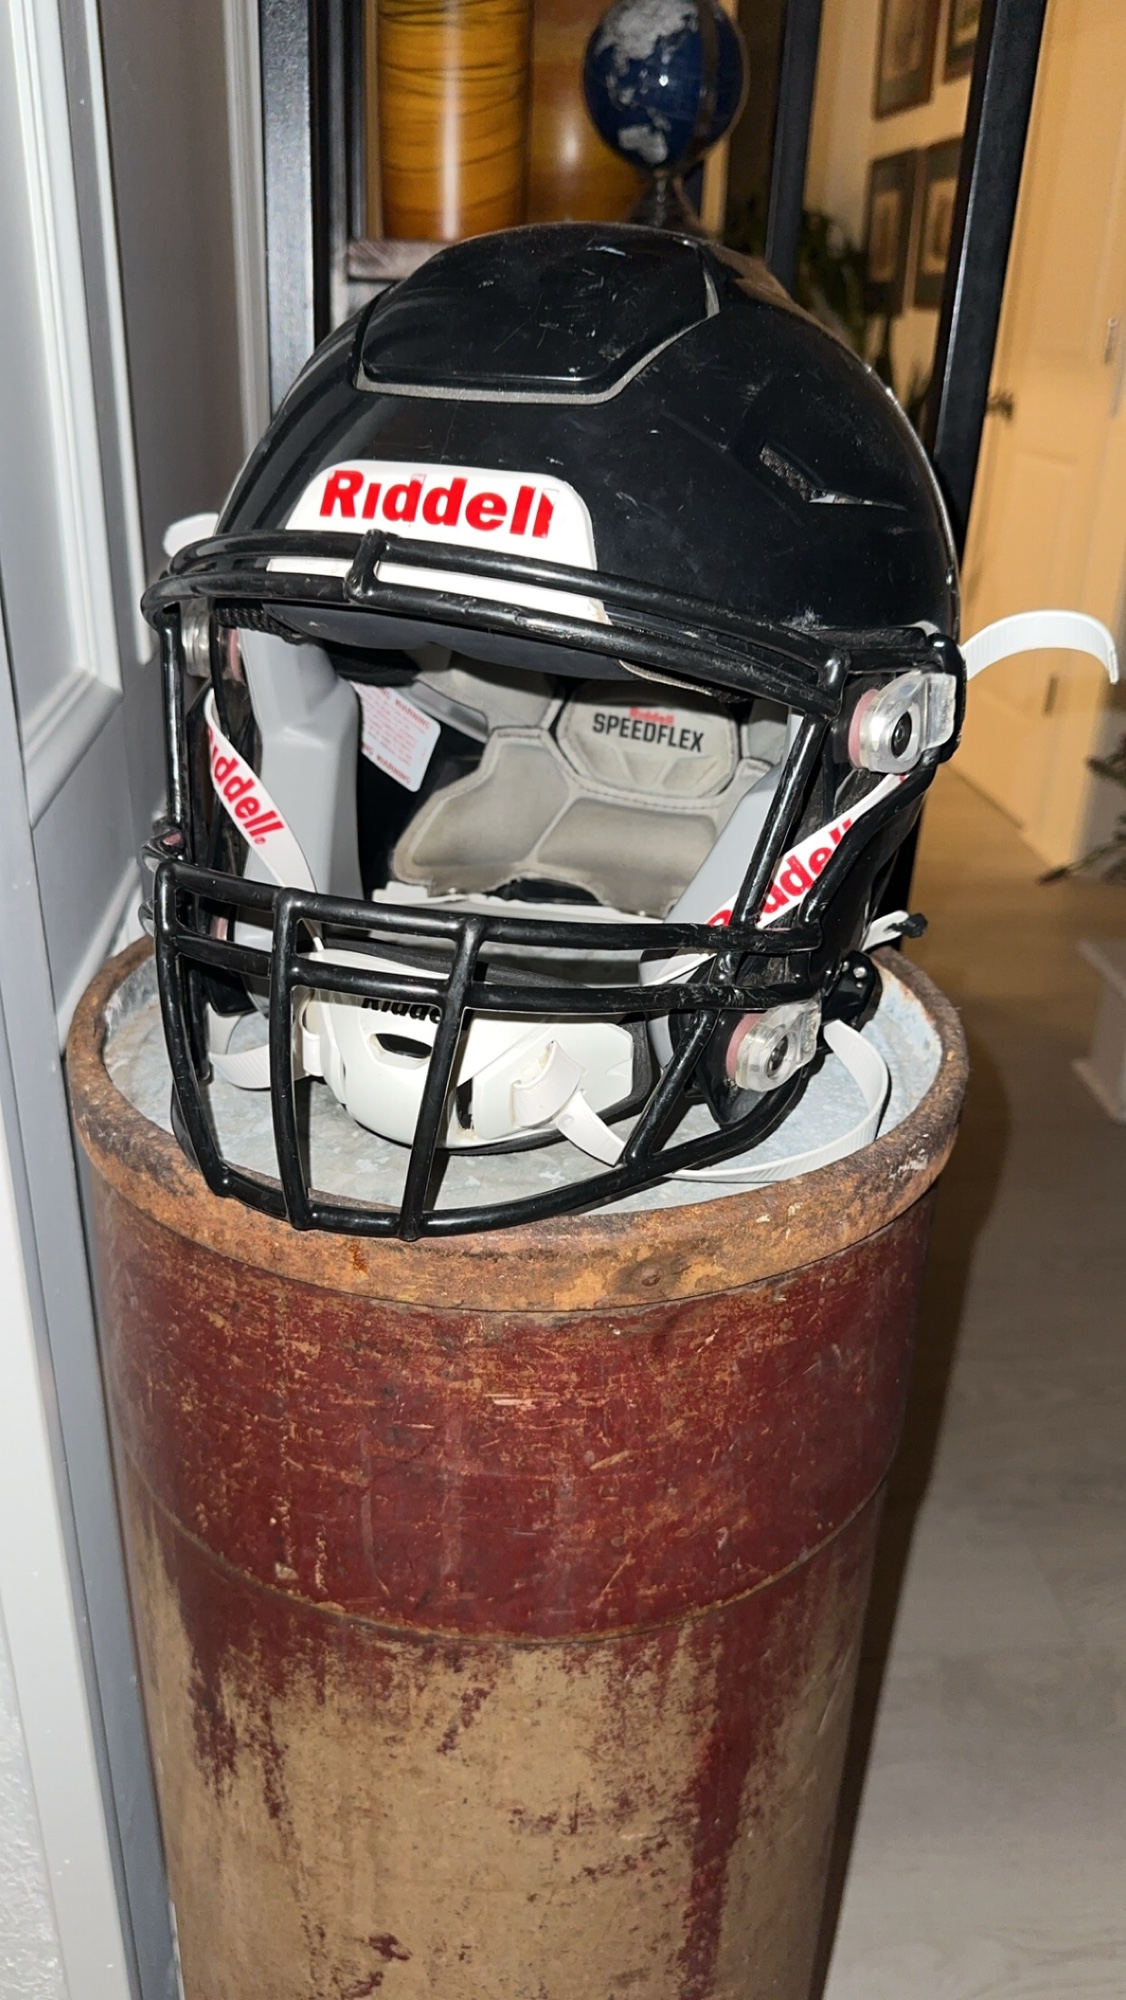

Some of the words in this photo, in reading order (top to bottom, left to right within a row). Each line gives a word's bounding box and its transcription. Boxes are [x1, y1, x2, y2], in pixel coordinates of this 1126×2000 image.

[319, 470, 556, 538] Riddell
[592, 713, 704, 752] SPEEDFLEX
[208, 724, 285, 838] ddell
